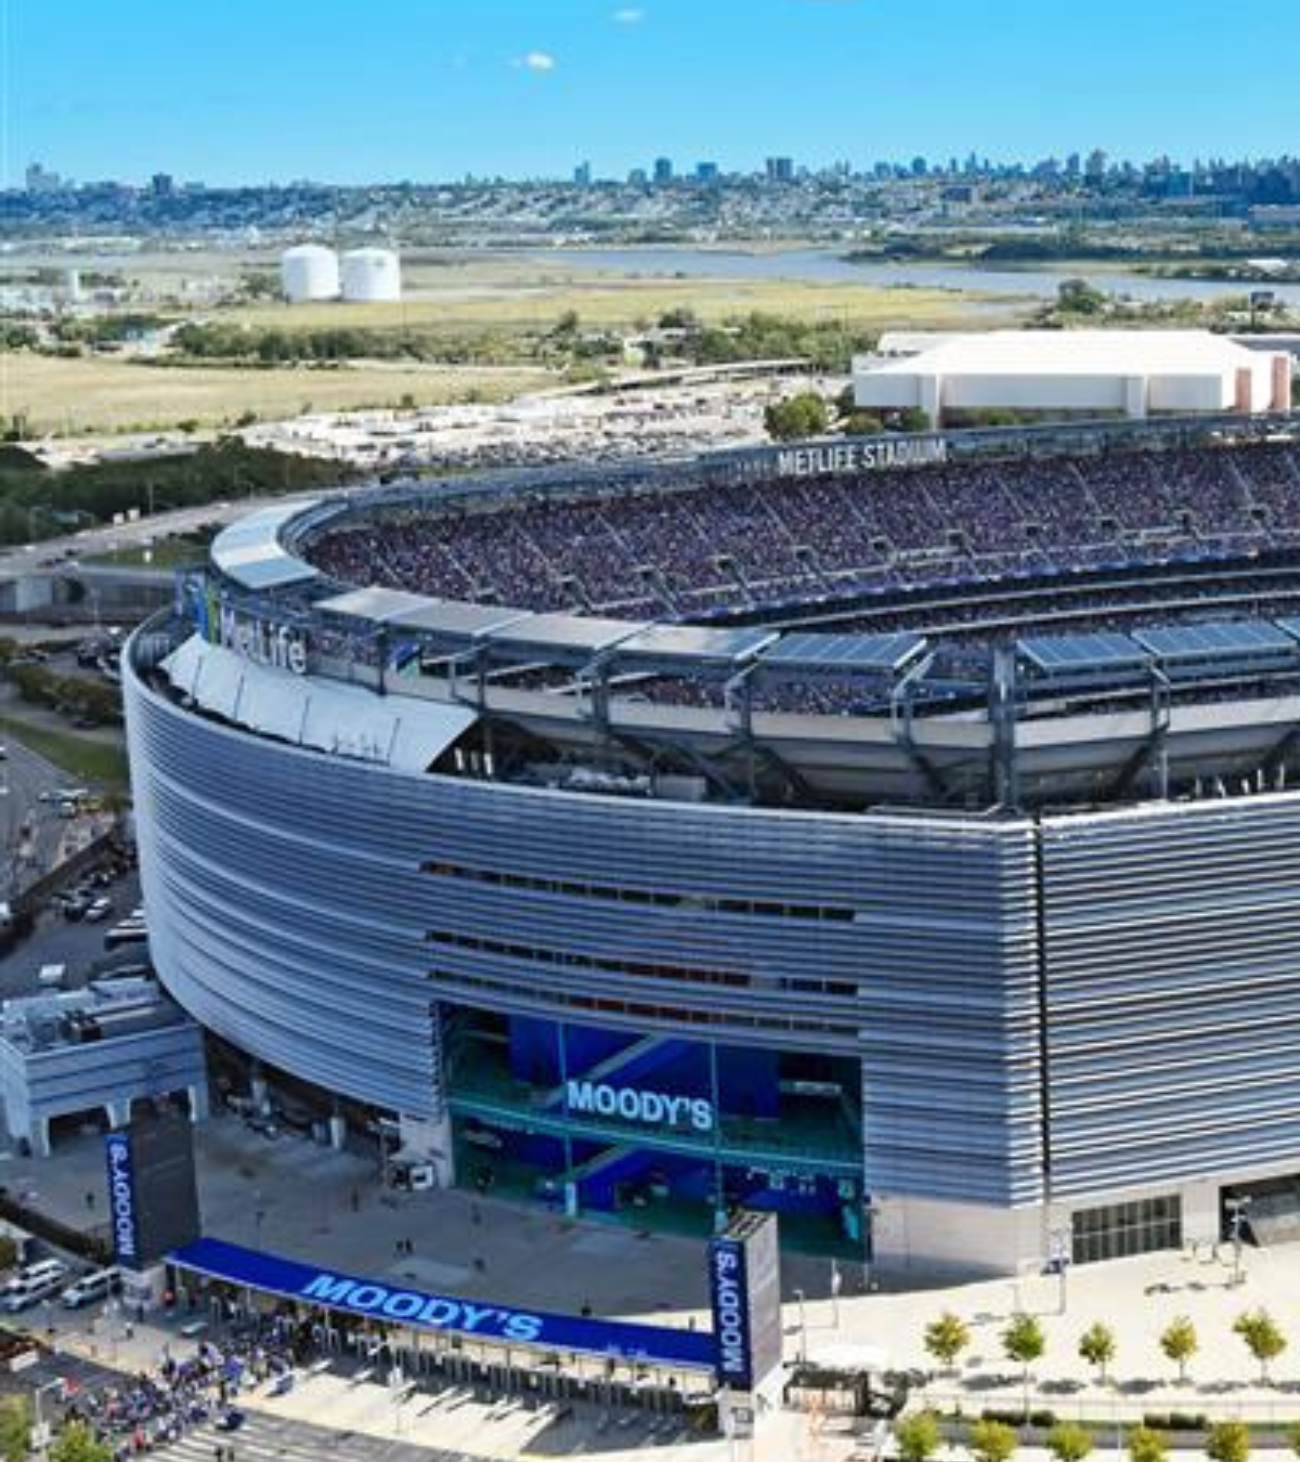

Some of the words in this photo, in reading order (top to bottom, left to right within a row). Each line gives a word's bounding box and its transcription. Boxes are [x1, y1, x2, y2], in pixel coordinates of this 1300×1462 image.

[779, 445, 857, 477] METLIFE
[860, 438, 947, 470] STADIUM
[220, 602, 307, 675] MetLife
[567, 1080, 713, 1130] MOODY'S
[109, 1143, 135, 1256] MOODY'S
[302, 1274, 543, 1341] MOODY'S
[715, 1251, 744, 1373] MOODY'S
